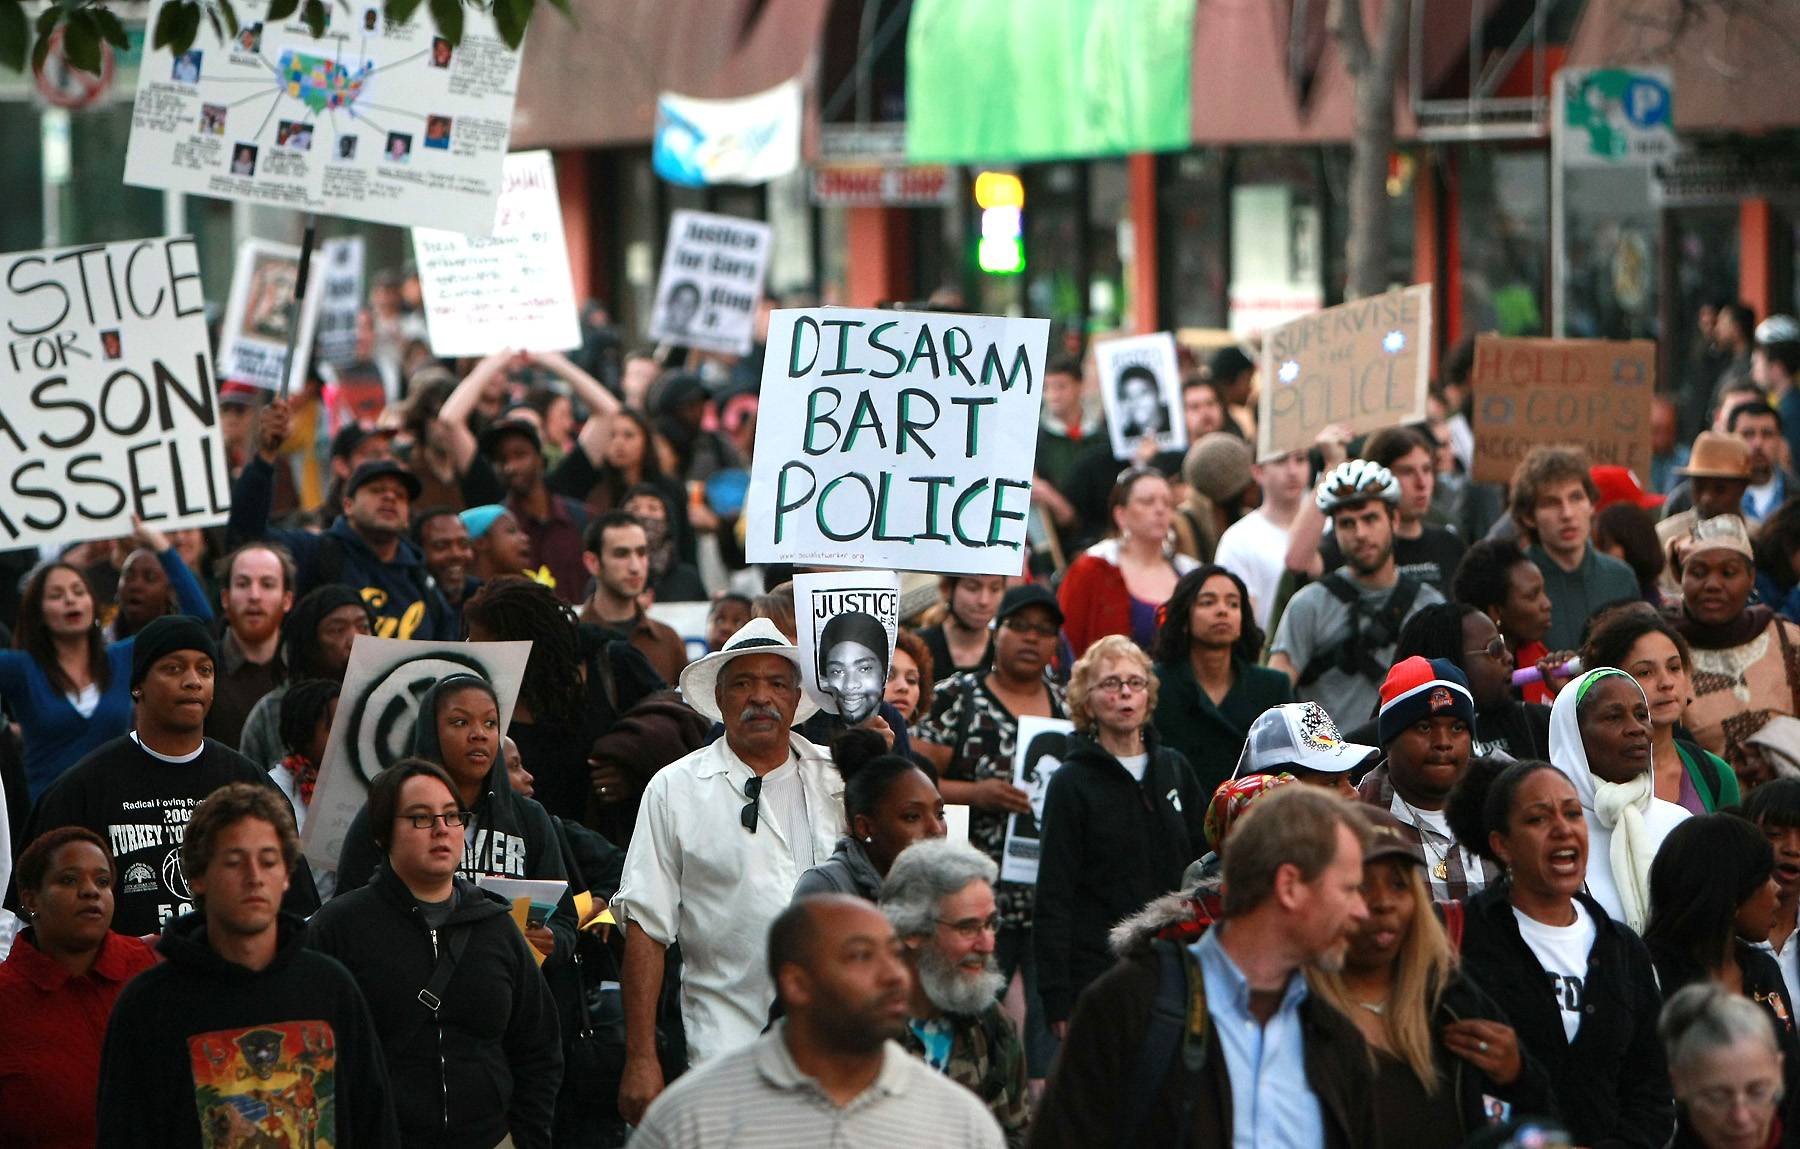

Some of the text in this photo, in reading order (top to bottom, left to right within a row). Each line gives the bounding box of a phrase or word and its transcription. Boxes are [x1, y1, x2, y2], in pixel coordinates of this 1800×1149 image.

[9, 331, 92, 372] FOR
[1273, 299, 1415, 361] SUPERVISE
[788, 315, 1033, 395] DISARM
[1478, 350, 1587, 387] HOLD
[803, 386, 998, 460] BART
[1526, 390, 1641, 433] COPS
[0, 435, 231, 538] SSELL
[773, 460, 1032, 550] POLICE
[815, 593, 897, 619] JUSTICE
[122, 800, 154, 811] Radical
[108, 824, 163, 858] TURKEY
